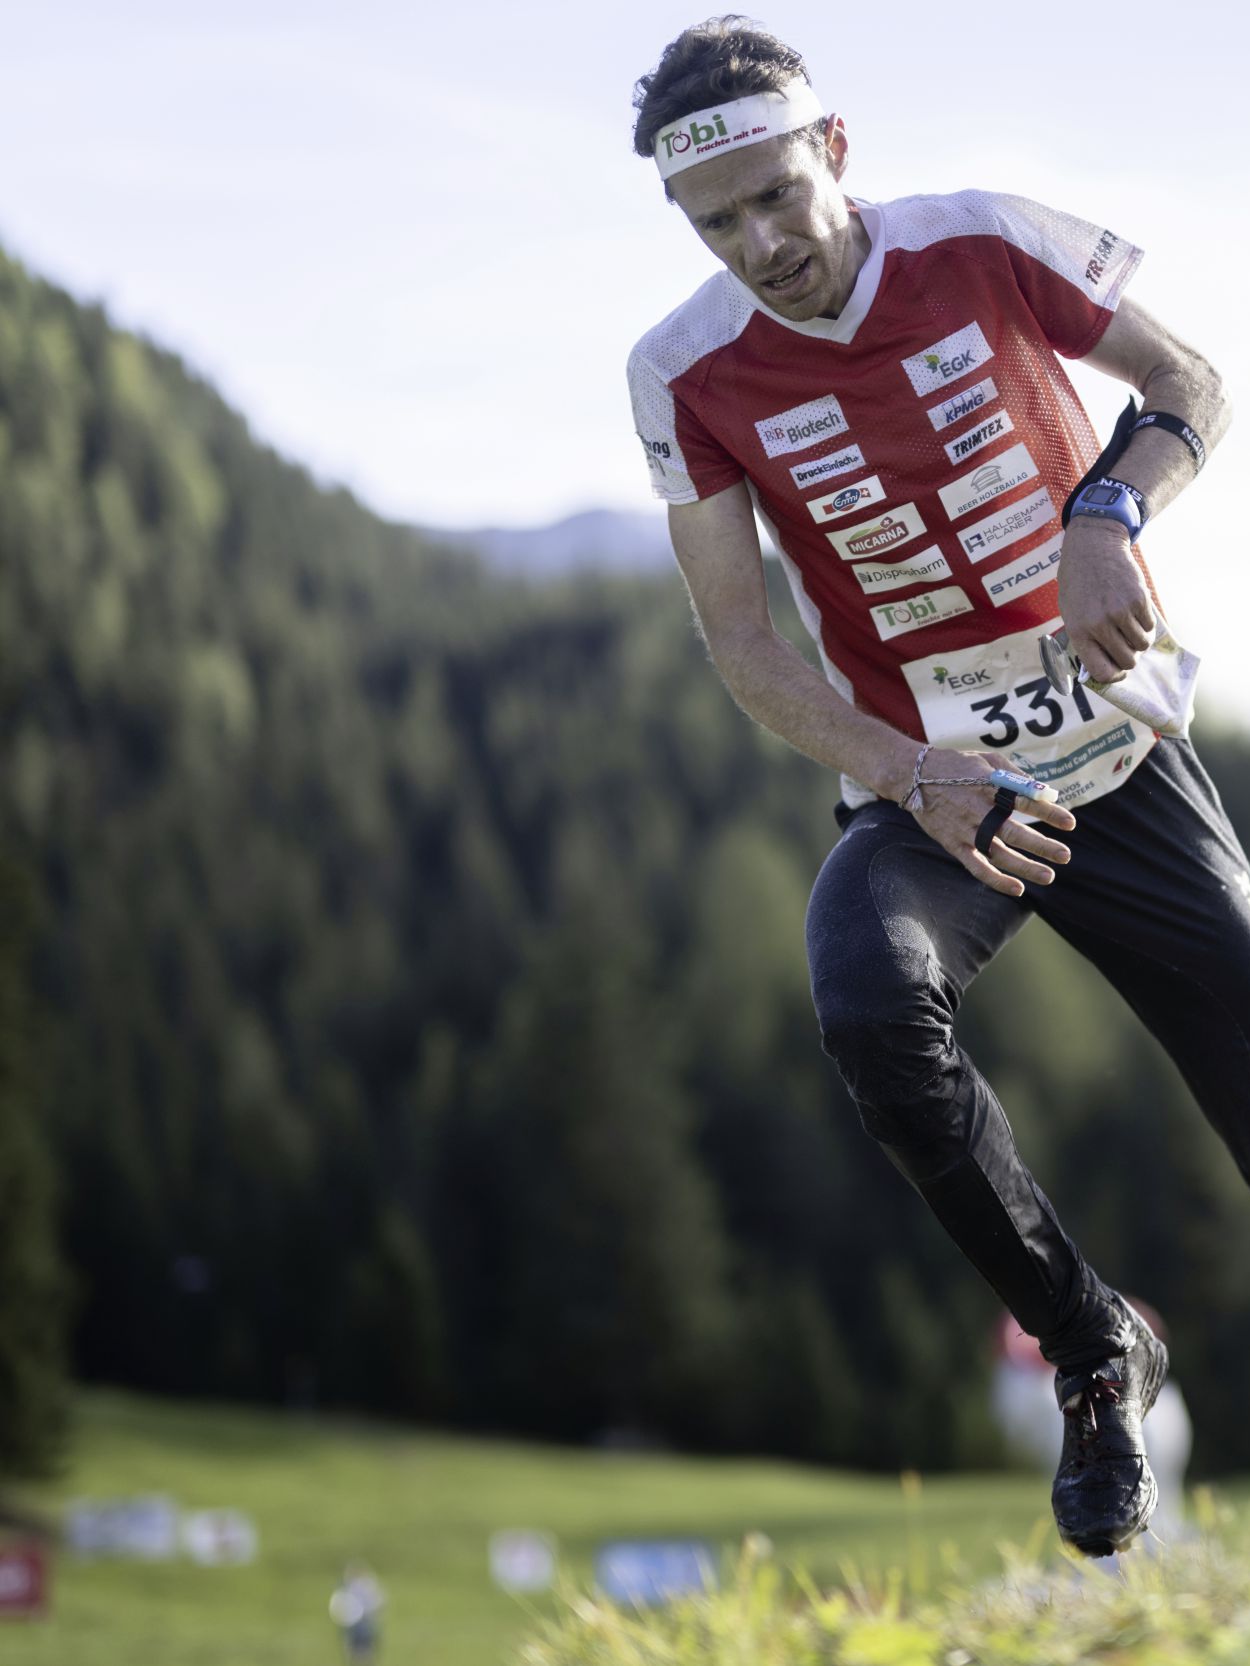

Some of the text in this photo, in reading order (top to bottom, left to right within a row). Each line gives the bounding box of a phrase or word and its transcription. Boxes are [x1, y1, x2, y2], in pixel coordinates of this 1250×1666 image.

[662, 113, 728, 158] Tobi
[696, 124, 768, 154] Früchte mit Biss
[939, 349, 977, 379] EGK
[944, 393, 985, 424] KPMG
[786, 411, 841, 444] Biotech
[952, 417, 1004, 458] TRIMTEX
[834, 492, 858, 507] Emmi
[957, 471, 1028, 514] BEER HOLZBAU AG
[983, 495, 1049, 536] HALDEMANN
[986, 516, 1033, 544] PLANER
[850, 525, 906, 553] MICARNA
[989, 550, 1061, 595] STADLE
[877, 595, 937, 627] Tobi
[947, 669, 991, 689] EGK
[970, 675, 1096, 749] 331
[1049, 762, 1073, 775] World
[1073, 752, 1088, 765] Cup
[1087, 739, 1107, 754] Final
[1107, 728, 1126, 743] 2022
[1058, 781, 1081, 797] AVOS
